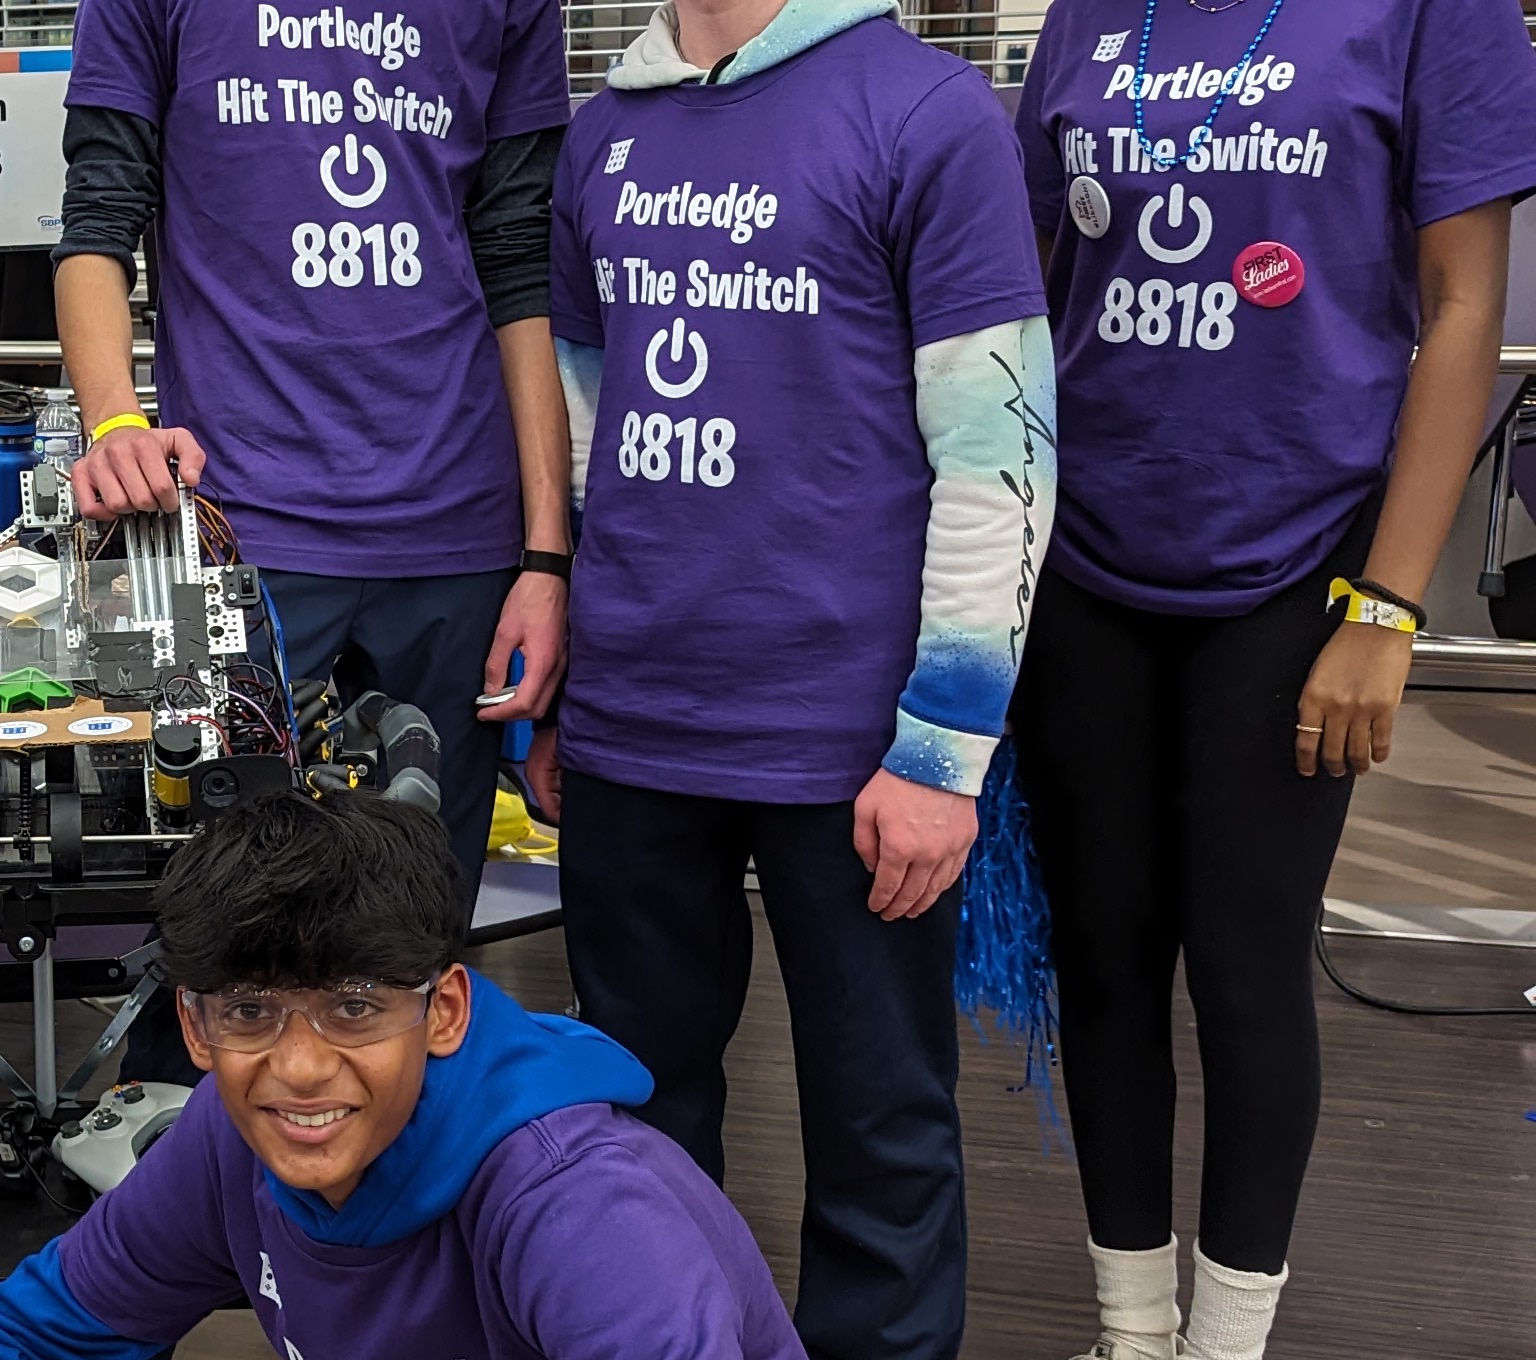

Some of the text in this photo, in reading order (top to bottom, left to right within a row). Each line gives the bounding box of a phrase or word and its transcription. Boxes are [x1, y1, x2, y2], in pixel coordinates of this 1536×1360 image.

[258, 3, 421, 70] Portledge
[217, 78, 453, 139] Hit The Switch
[1103, 55, 1295, 106] Portledge
[1065, 121, 1328, 177] Hit The Switch
[615, 181, 777, 244] Portledge
[291, 221, 422, 288] 8818
[593, 257, 819, 314] Hit The Switch
[1242, 258, 1289, 290] Ladies
[1098, 277, 1238, 351] 8818
[619, 410, 736, 488] 8818
